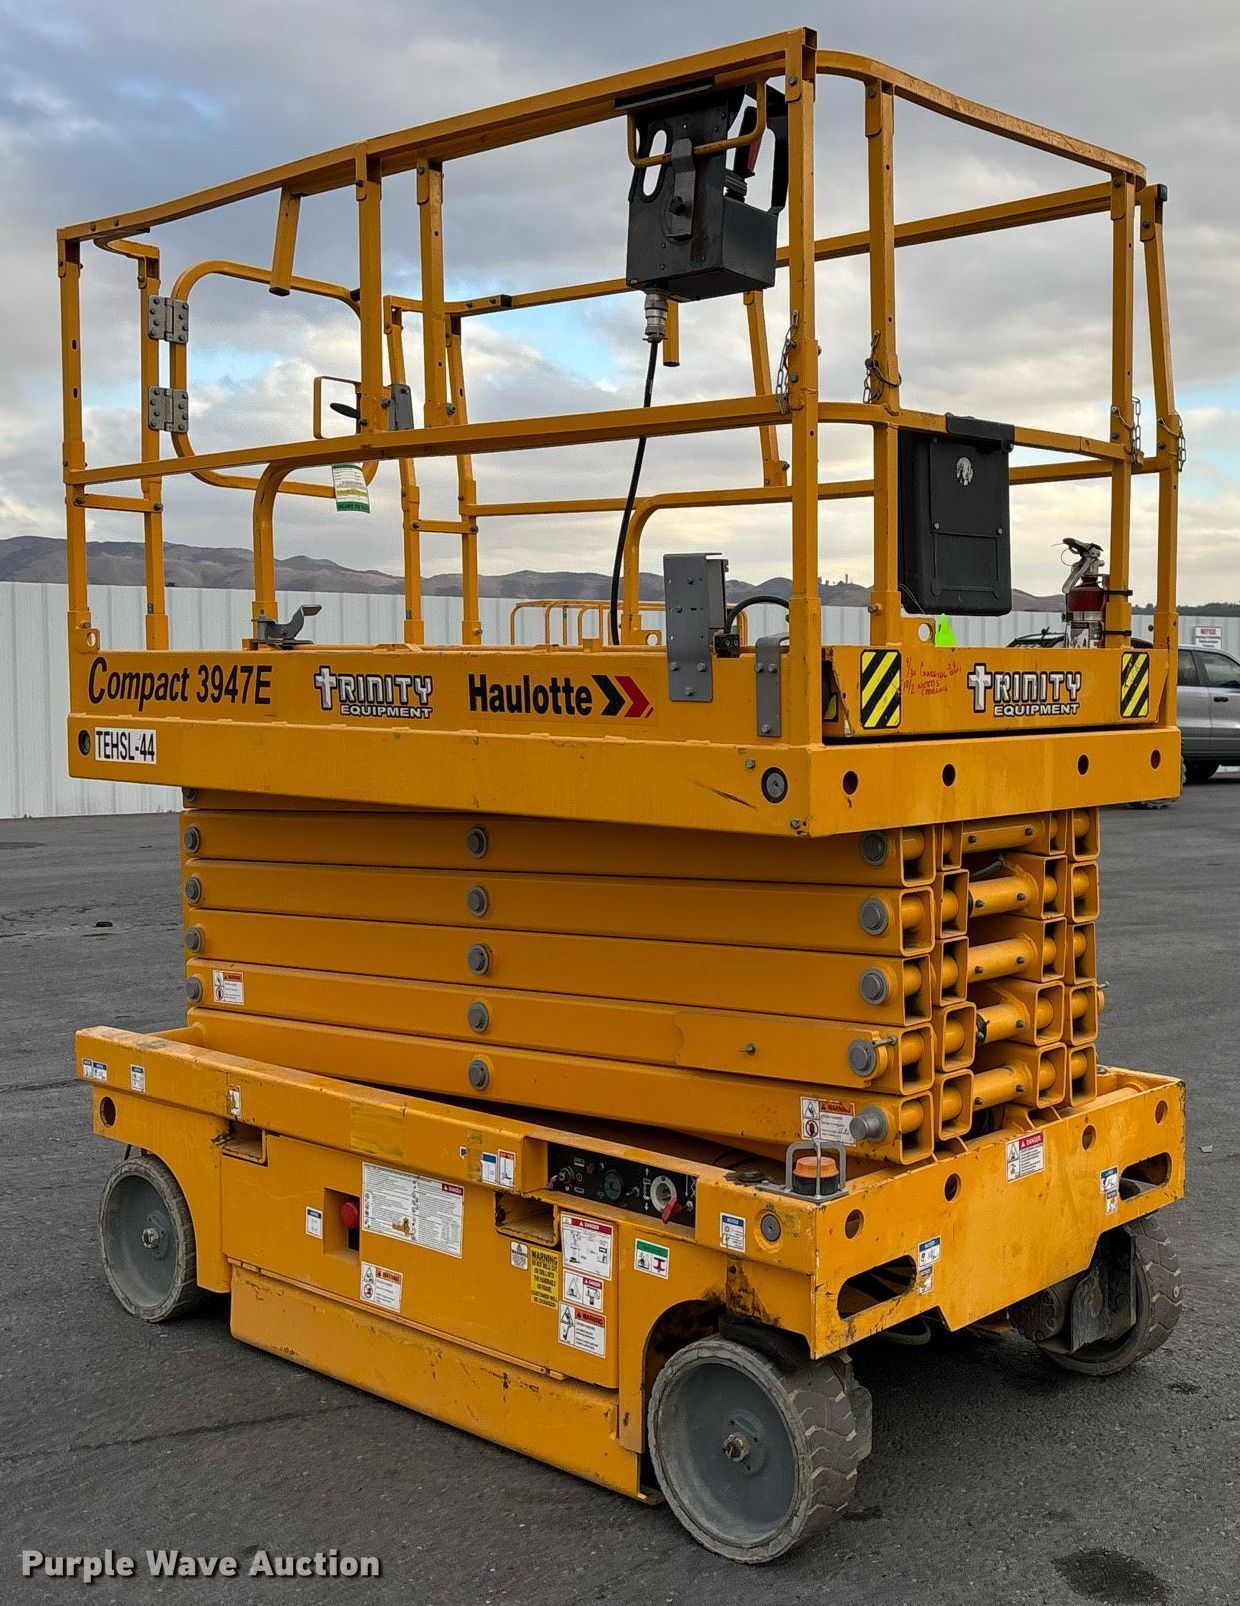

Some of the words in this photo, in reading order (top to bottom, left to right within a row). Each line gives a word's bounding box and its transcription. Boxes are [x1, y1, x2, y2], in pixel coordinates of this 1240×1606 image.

[88, 656, 190, 712] Compact
[196, 664, 273, 705] 3947E
[468, 673, 593, 716] Haulotte
[340, 704, 433, 718] EQUIPMENT
[994, 702, 1080, 717] EQUIPMENT
[96, 730, 155, 762] TEHSL-44
[532, 1250, 557, 1266] WARNING
